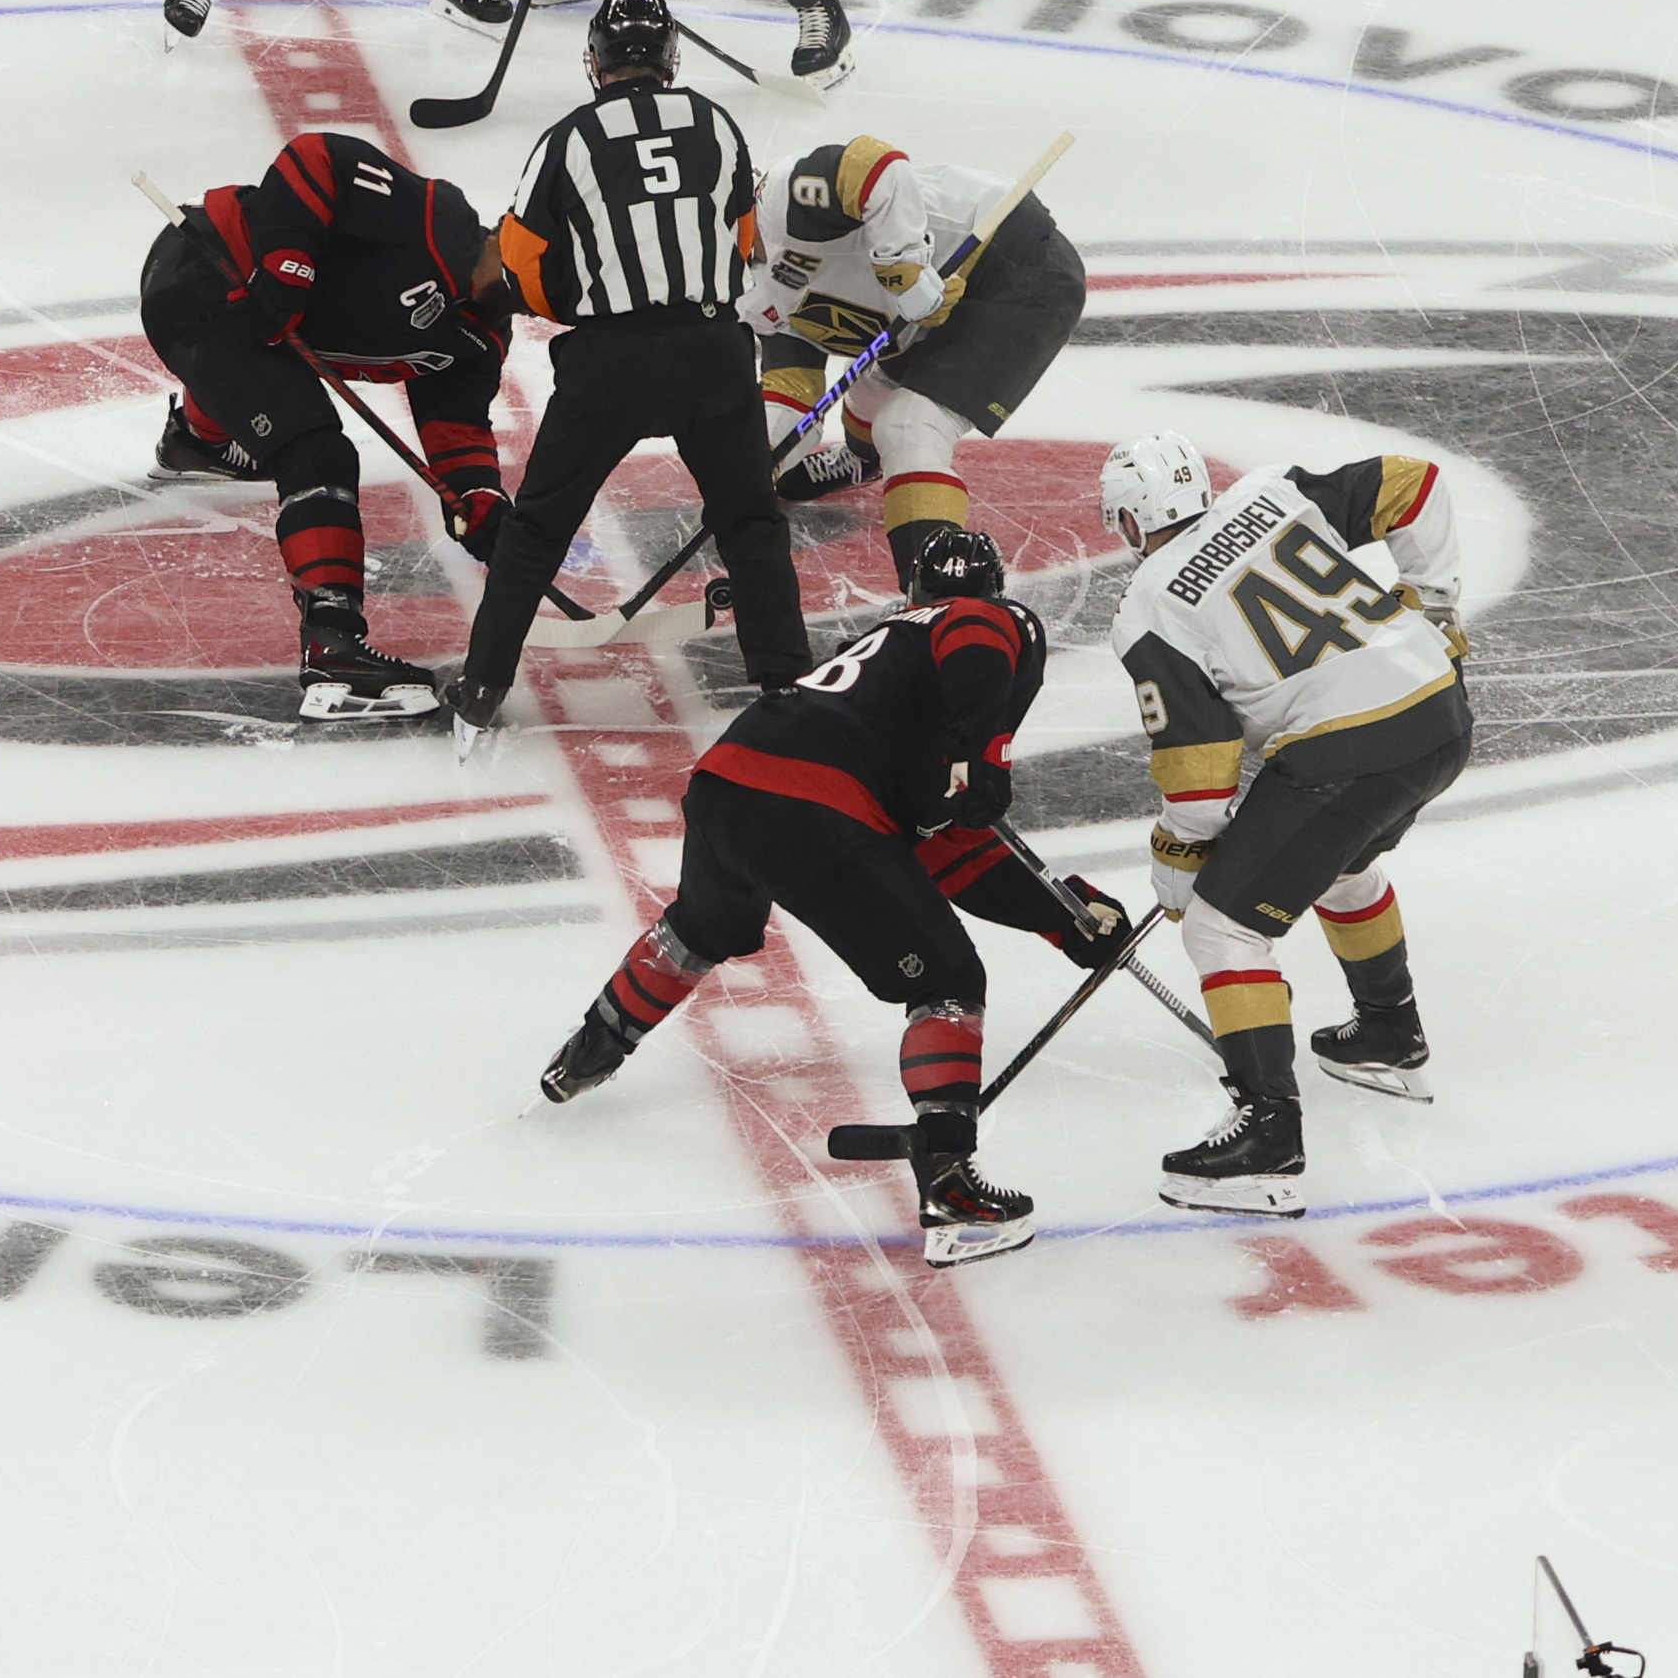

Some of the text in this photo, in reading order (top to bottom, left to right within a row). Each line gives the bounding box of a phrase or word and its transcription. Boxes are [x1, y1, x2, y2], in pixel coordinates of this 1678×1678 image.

[351, 160, 393, 197] 11
[634, 135, 681, 195] 5
[399, 279, 437, 308] C
[1173, 465, 1193, 485] 49
[940, 556, 966, 578] 48
[1166, 494, 1289, 608] BARBASHEV
[1227, 520, 1406, 681] 49
[1128, 955, 1189, 1020] WARRIOR
